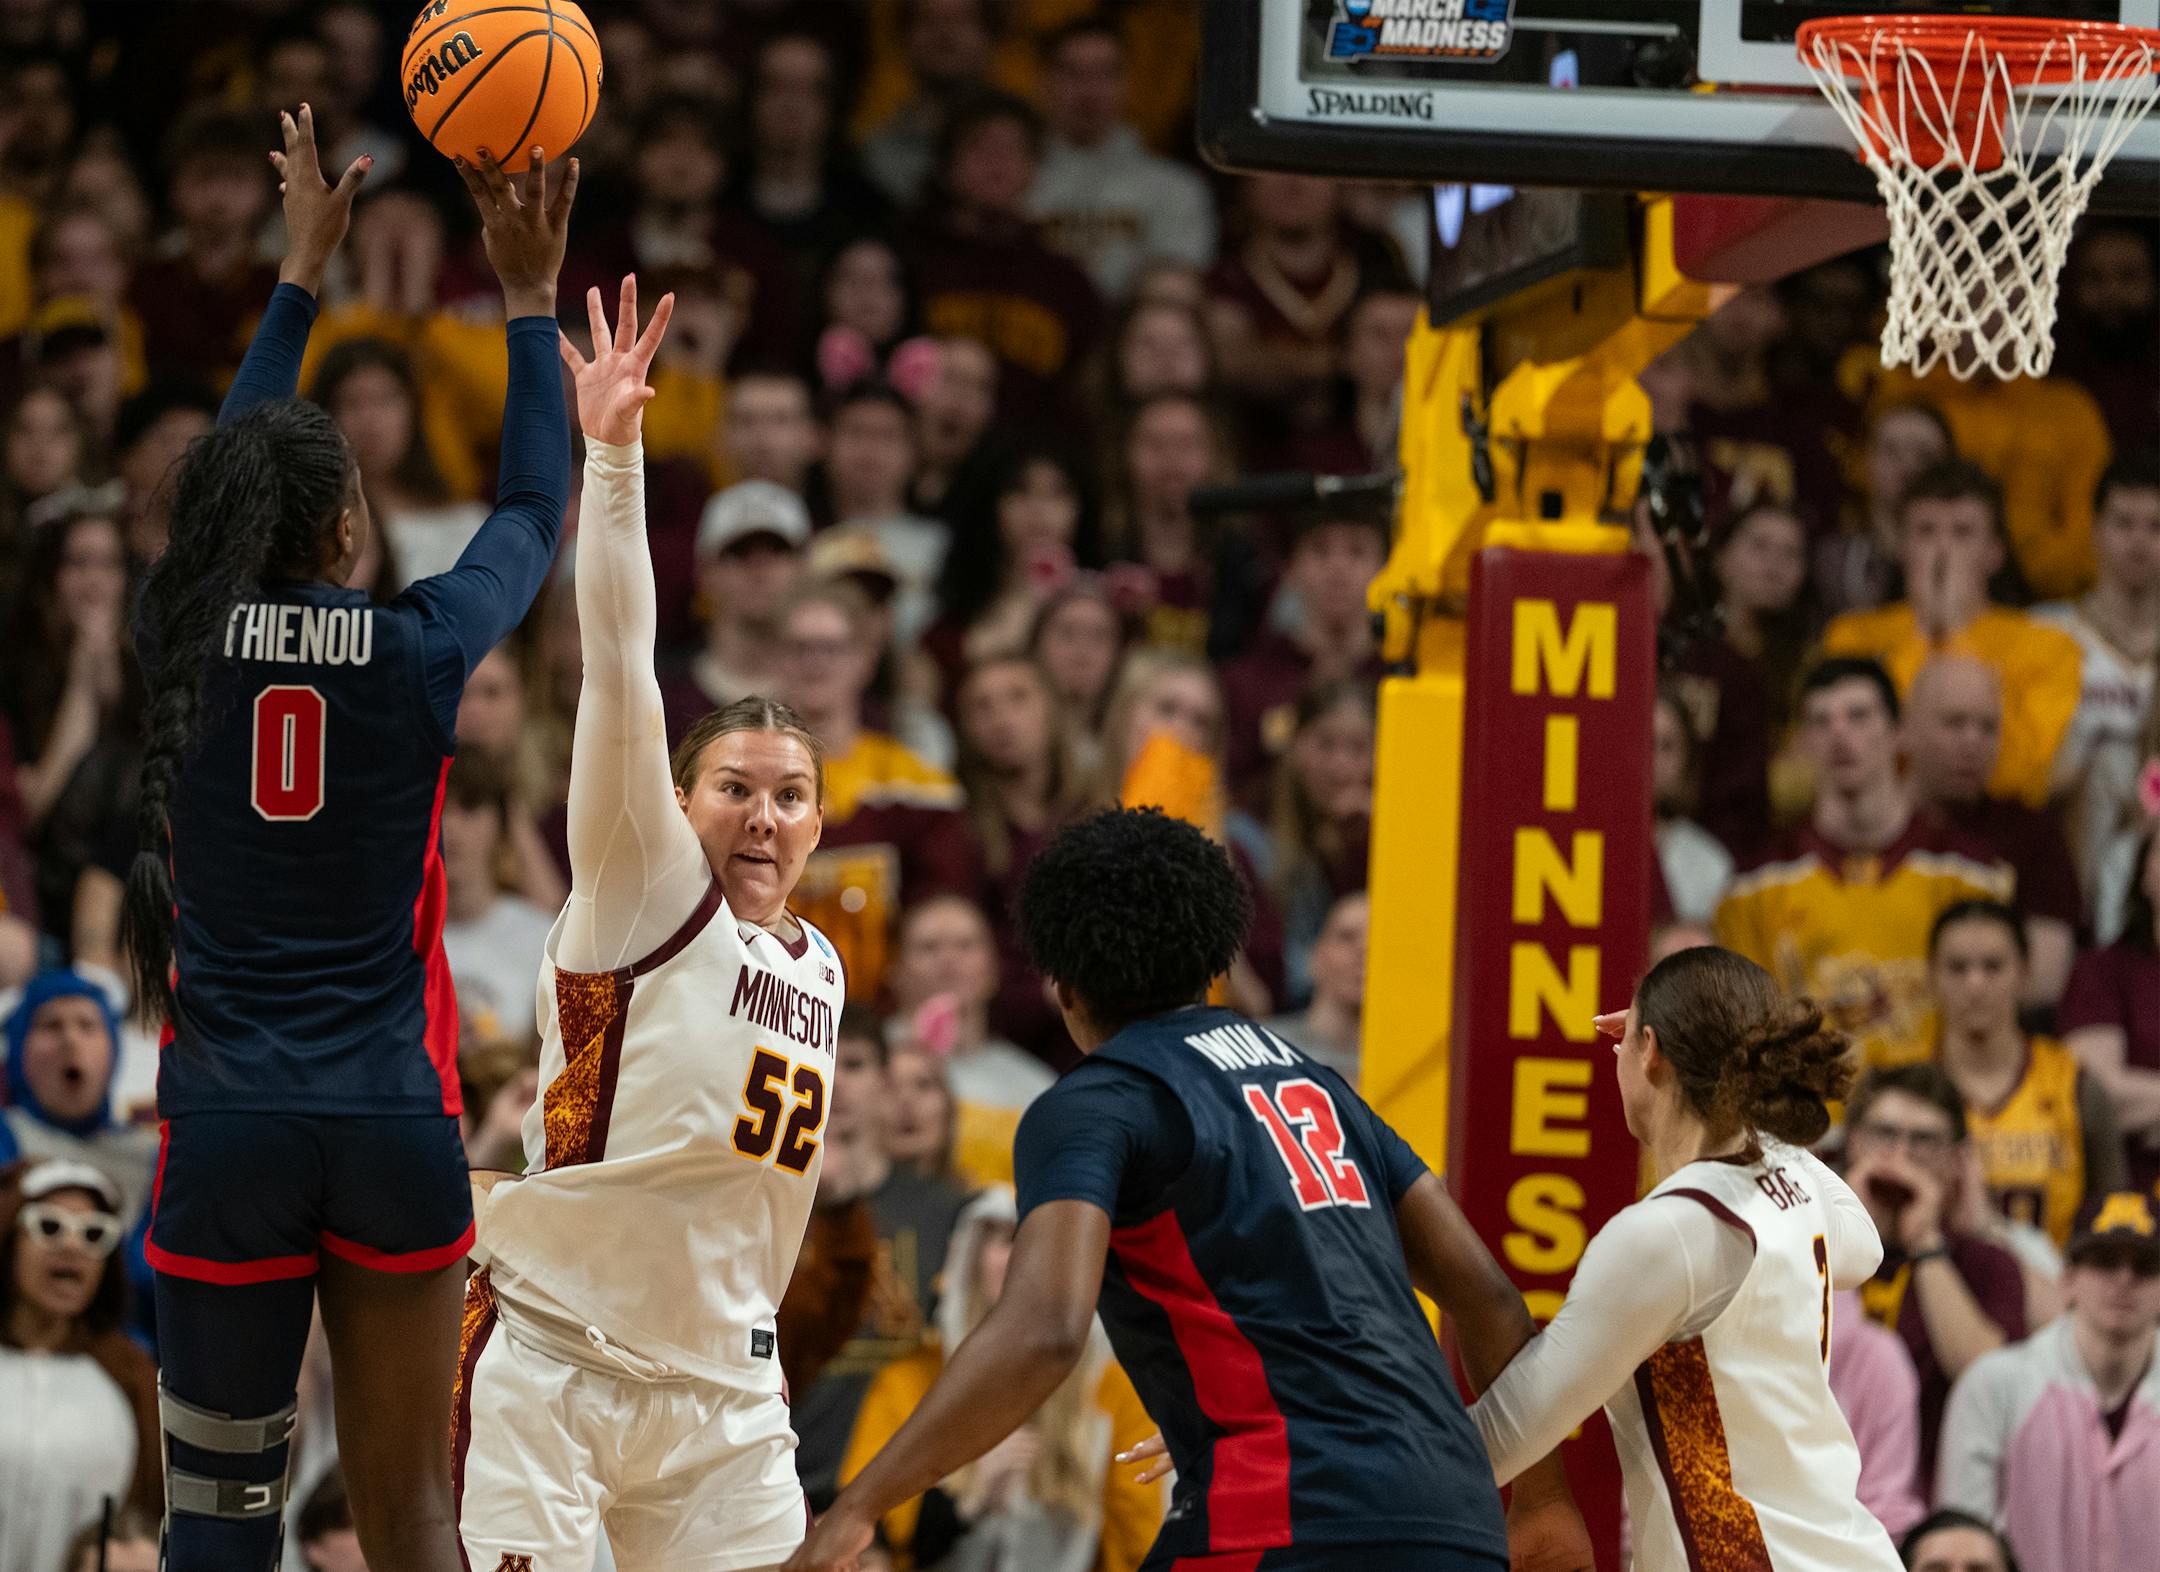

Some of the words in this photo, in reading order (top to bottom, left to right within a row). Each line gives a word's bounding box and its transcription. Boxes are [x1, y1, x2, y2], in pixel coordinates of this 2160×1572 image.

[1369, 0, 1464, 18] MARCH
[1379, 18, 1506, 49] MADNESS
[404, 31, 483, 117] Wilso
[1306, 88, 1435, 120] SPALDING
[251, 685, 327, 821] 0
[729, 964, 834, 1060] MINNESOTA
[1501, 599, 1617, 1440] MINNES
[730, 1045, 825, 1178] 52
[1241, 1077, 1371, 1212] 12
